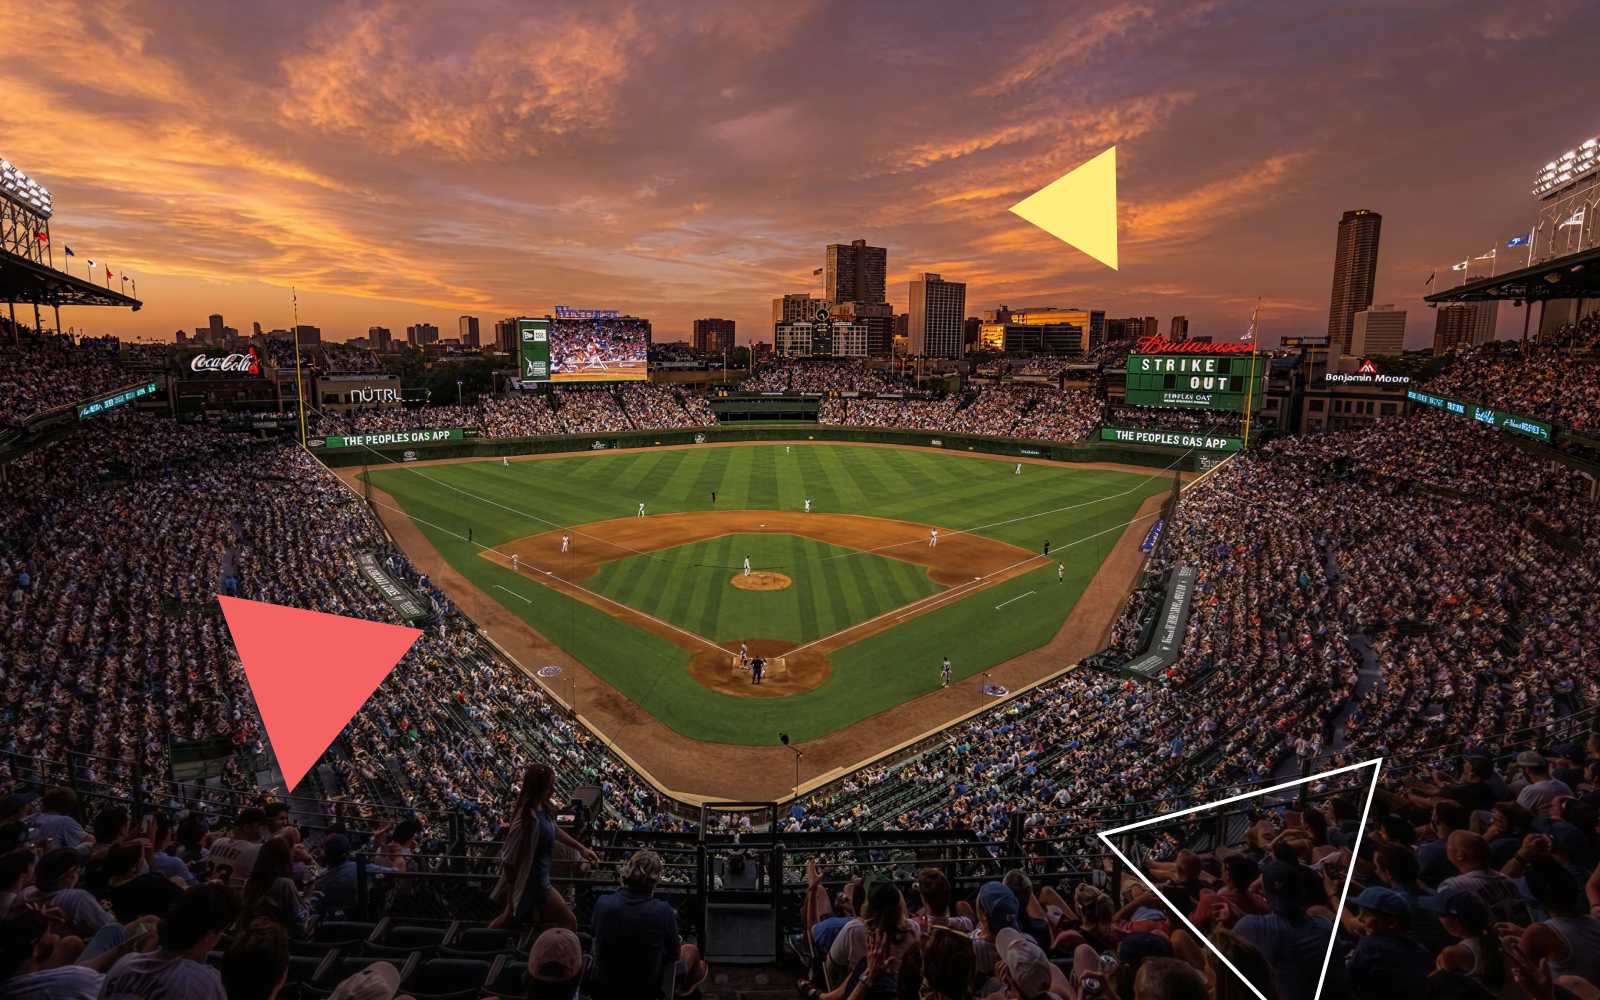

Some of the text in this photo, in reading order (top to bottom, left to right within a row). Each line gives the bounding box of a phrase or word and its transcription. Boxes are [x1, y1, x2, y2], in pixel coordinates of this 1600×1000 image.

[1141, 358, 1215, 372] STRIKE
[1190, 376, 1228, 390] OUT
[342, 430, 451, 446] THE PEOPLES GAS APP
[1115, 430, 1227, 449] THE PEOPLES GAS APP
